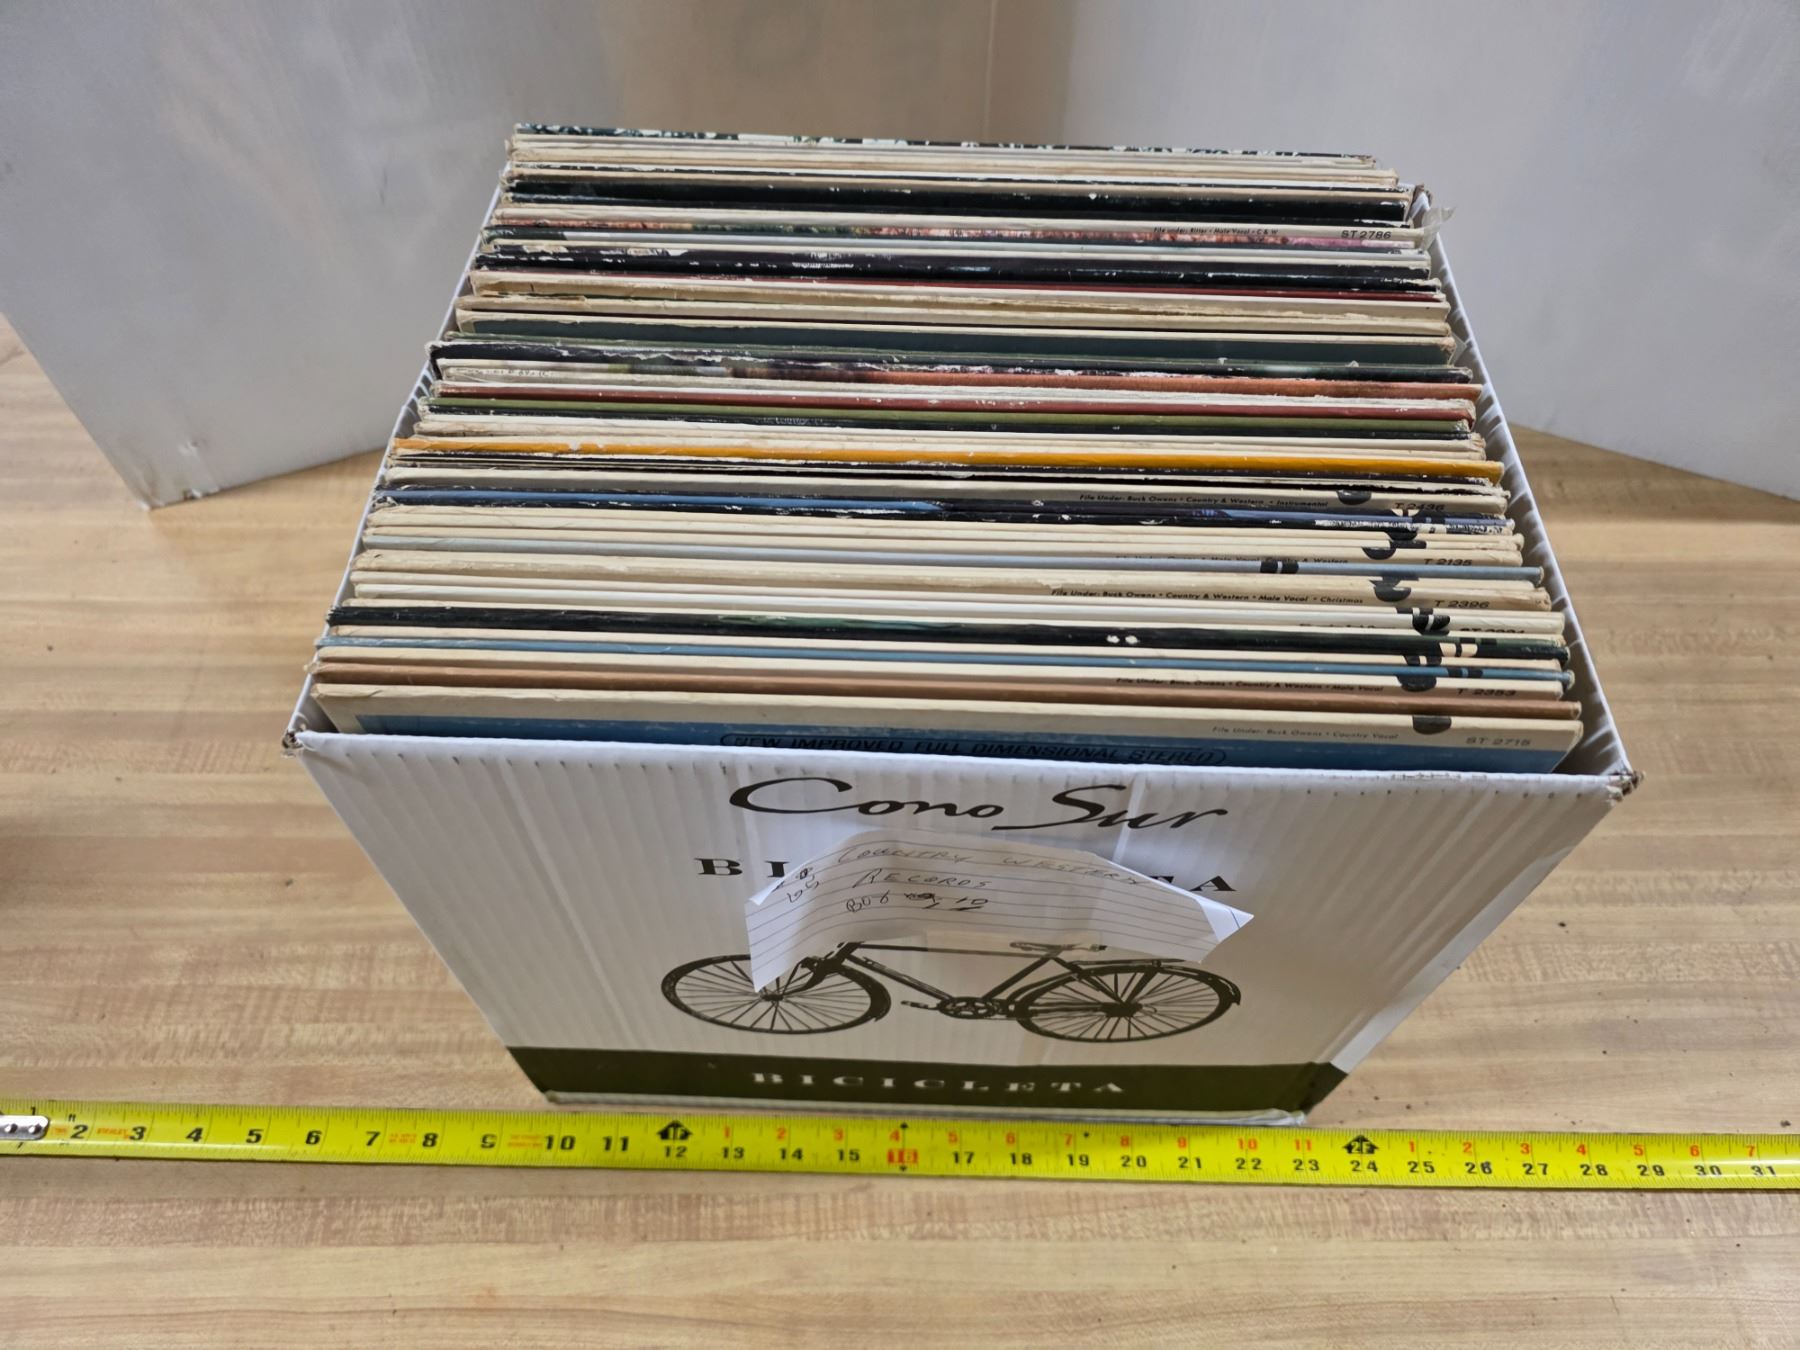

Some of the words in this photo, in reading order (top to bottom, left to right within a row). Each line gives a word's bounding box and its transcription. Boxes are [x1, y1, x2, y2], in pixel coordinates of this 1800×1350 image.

[1341, 230, 1357, 238] ST
[1359, 230, 1392, 239] 2786
[1165, 592, 1201, 601] Country
[1213, 593, 1250, 601] Western
[1284, 595, 1309, 603] Vocal
[1320, 596, 1364, 604] Christmas
[791, 738, 904, 751] IMPROVED
[914, 741, 960, 753] FULL
[972, 742, 1117, 760] DIMENSIONAL
[1127, 749, 1216, 763] STEREO
[1465, 736, 1489, 744] ST
[729, 777, 1003, 816] Cono
[992, 784, 1228, 831] Sur
[752, 1072, 1122, 1093] BICICLETA
[70, 1124, 89, 1139] 2
[129, 1126, 147, 1141] 3
[185, 1127, 204, 1142] 4
[246, 1128, 264, 1144] 5
[305, 1130, 322, 1145] 6
[366, 1131, 381, 1147] 7
[421, 1132, 438, 1148] 8
[544, 1134, 576, 1151] 10
[602, 1136, 630, 1152] 11
[664, 1145, 688, 1159] 12
[722, 1147, 745, 1160] 13
[779, 1147, 804, 1162] 14
[837, 1148, 860, 1162] 15
[952, 1151, 975, 1165] 17
[1010, 1152, 1033, 1166] 18
[1067, 1154, 1090, 1167] 19
[1121, 1155, 1148, 1168] 20
[1178, 1156, 1203, 1169] 21
[1235, 1157, 1263, 1170] 22
[1292, 1158, 1320, 1172] 23
[1350, 1159, 1379, 1173] 24
[1407, 1160, 1435, 1174] 25
[1464, 1161, 1493, 1175] 26
[1522, 1162, 1549, 1176] 27
[1579, 1163, 1609, 1176] 28
[1636, 1164, 1665, 1177] 29
[1694, 1165, 1722, 1176] 30
[1750, 1165, 1777, 1177] 31
[723, 1126, 731, 1139] 1
[776, 1127, 786, 1140] 2
[889, 1130, 900, 1142] 4
[948, 1132, 958, 1144] 5
[1064, 1134, 1073, 1146] 7
[1237, 1139, 1258, 1151] 10
[1294, 1139, 1313, 1151] 11
[1408, 1140, 1416, 1152] 1
[1463, 1142, 1473, 1155] 2
[1520, 1143, 1530, 1155] 3
[1576, 1143, 1586, 1156] 4
[1633, 1144, 1644, 1156] 5
[1690, 1144, 1700, 1157] 6
[1746, 1145, 1755, 1157] 7
